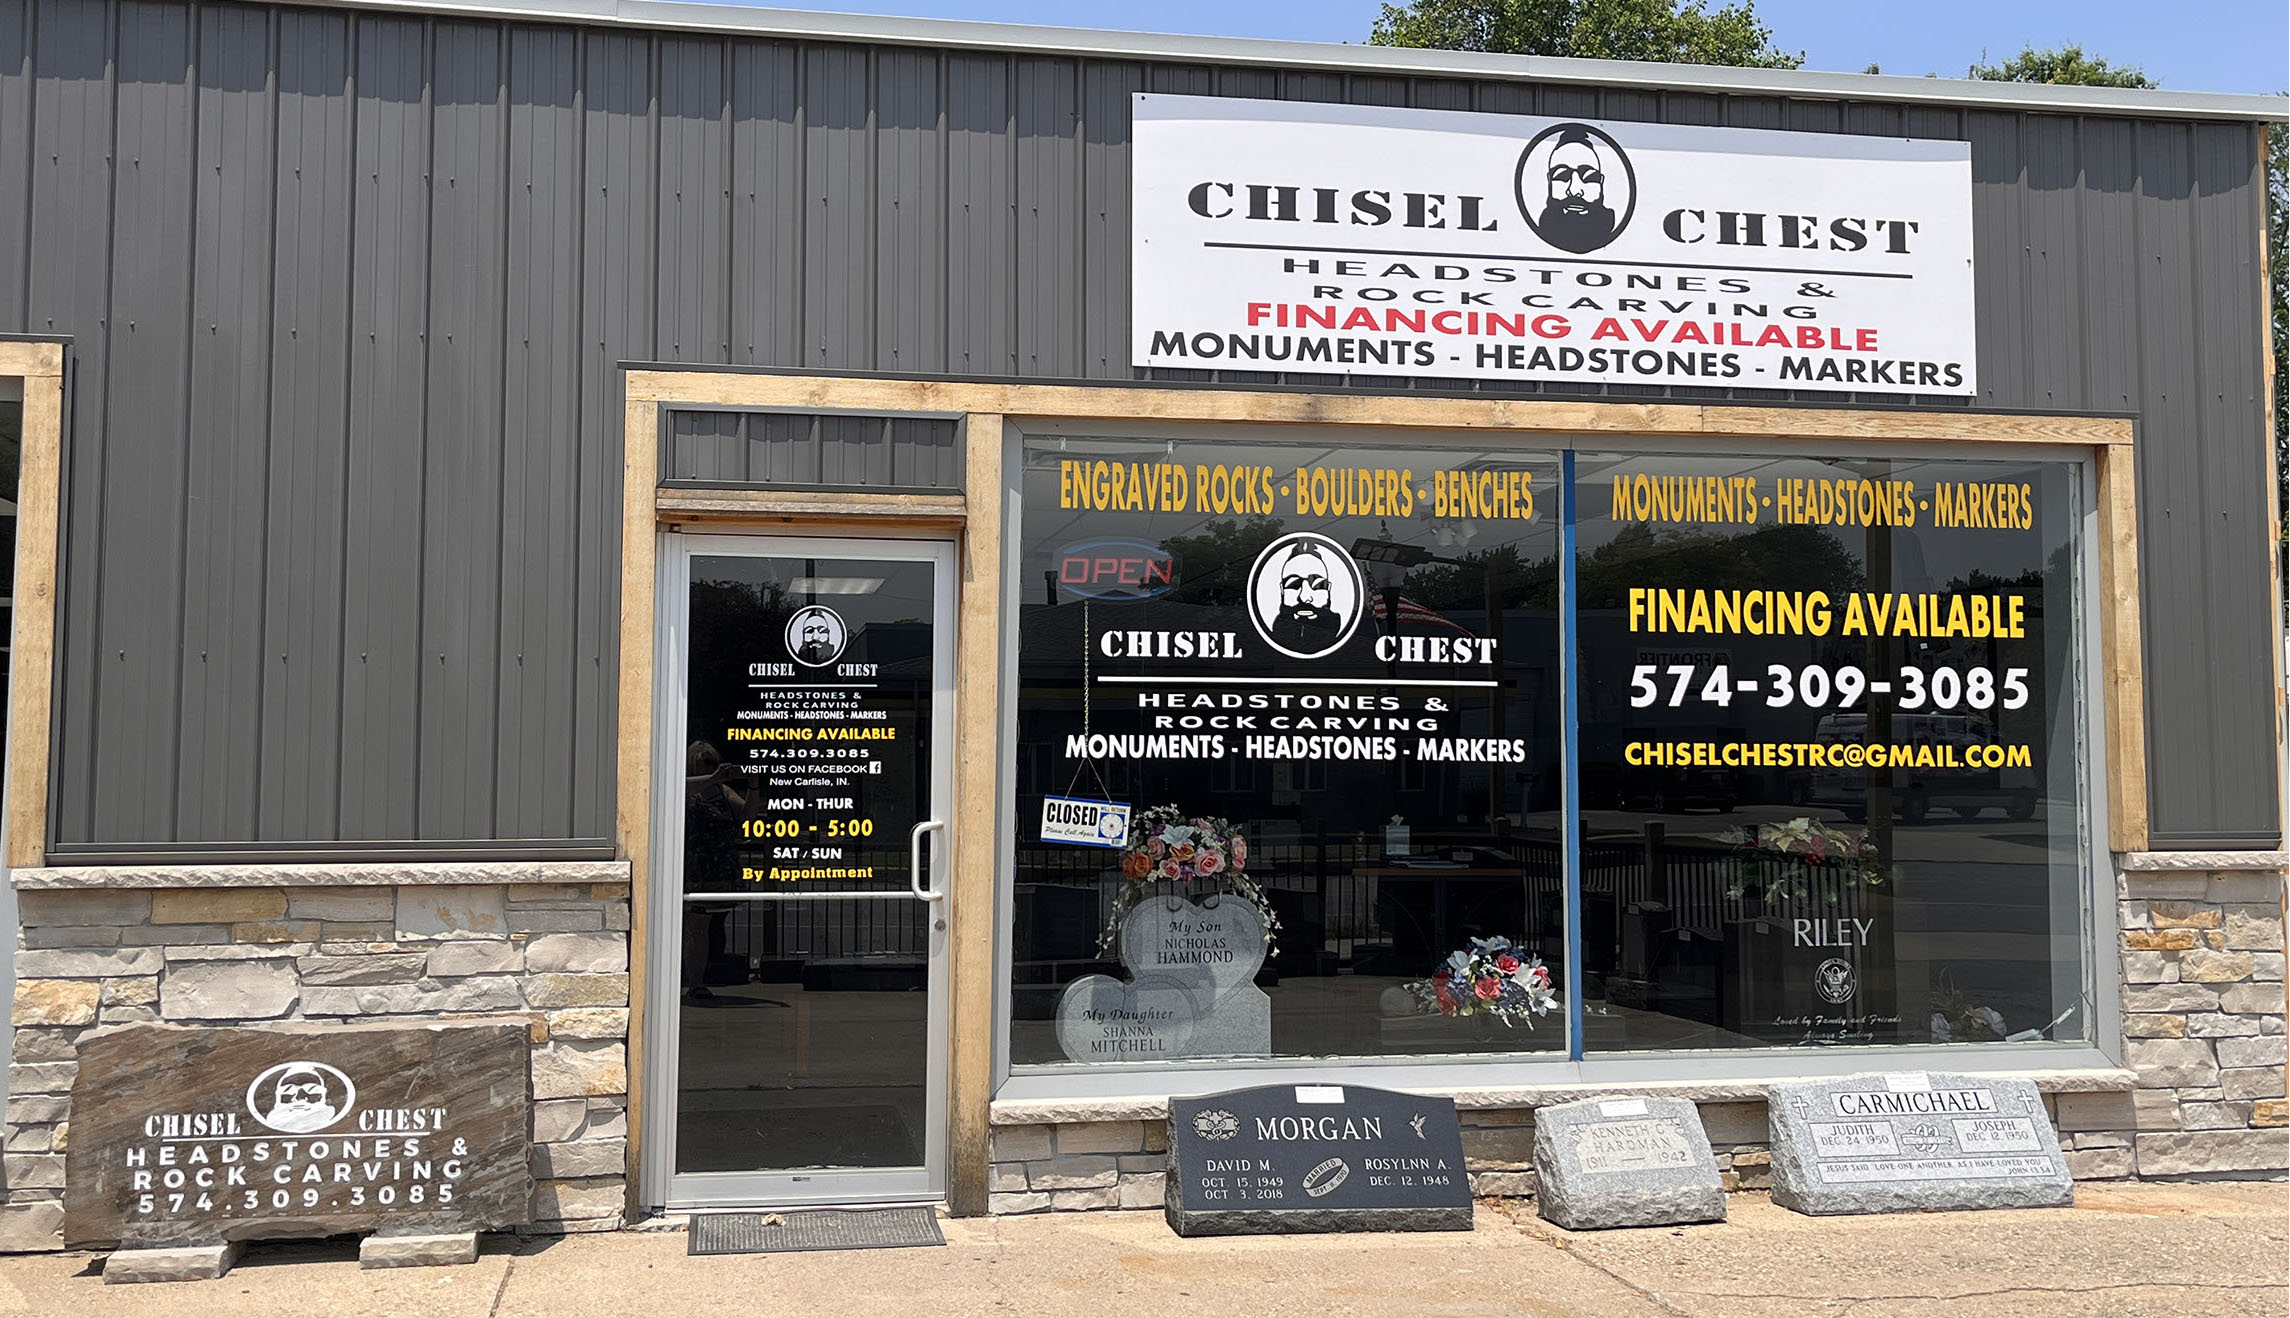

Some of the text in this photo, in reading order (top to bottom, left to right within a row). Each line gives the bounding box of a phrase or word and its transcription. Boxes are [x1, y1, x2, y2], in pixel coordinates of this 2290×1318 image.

[1188, 183, 1918, 253] CHISEL CHEST
[1284, 258, 1835, 297] HEADSTONES &
[1314, 286, 1817, 319] ROCK CARVING
[1248, 303, 1877, 351] FINANCING AVAILABLE
[1151, 331, 1434, 366] MONUMENTS
[1476, 344, 1742, 379] HEADSTONES
[1780, 356, 1962, 387] MARKERS
[1060, 460, 1533, 519] ENGRAVED ROCKS BOULDERS BENCHES
[1612, 474, 2032, 530] MONUMENTS HEADSTONES MARKERS
[1060, 557, 1173, 584] OPEN
[1630, 588, 2024, 638] FINANCING AVAILABLE
[1101, 631, 1496, 663] CHISEL CHEST
[749, 664, 877, 676] CHISEL CHEST
[1631, 665, 2028, 709] 574-309-3085
[1140, 694, 1448, 711] HEADSTONES &
[737, 711, 788, 719] MONUMENTS
[795, 711, 844, 719] HEADSTONES
[851, 711, 886, 719] MARKERS
[1156, 716, 1437, 730] ROCK CARVING
[728, 728, 895, 740] FINANCING AVAILABLE
[750, 749, 868, 758] 574.309.3085
[1066, 735, 1224, 758] MONUMENTS
[1247, 736, 1396, 760] HEADSTONES
[1418, 738, 1524, 762] MARKERS
[1625, 742, 2031, 767] CHISELCHESTRC@GMAIL.COM
[771, 765, 786, 773] US
[789, 765, 805, 773] ON
[808, 765, 867, 773] FACEBOOK
[795, 778, 833, 786] Carlisle,
[768, 799, 804, 810] MON
[816, 798, 853, 809] THUR
[1047, 802, 1098, 826] CLOSED
[743, 820, 799, 837] 10:00
[828, 819, 872, 836] 5:00
[773, 847, 799, 858] SAT
[812, 848, 841, 859] SUN
[743, 867, 872, 881] By Appointment
[1169, 920, 1221, 936] My Son
[1793, 918, 1873, 947] RILEY
[1165, 938, 1226, 950] NICHOLAS
[1157, 950, 1233, 964] HAMMOND
[1083, 1007, 1174, 1024] My Daughter
[1801, 1016, 1812, 1027] by
[1815, 1015, 1847, 1026] Family
[1848, 1016, 1866, 1024] and
[1103, 1027, 1153, 1038] SHANNA
[1091, 1039, 1166, 1053] MITCHELL
[1840, 1092, 1989, 1115] CARMICHAEL
[145, 1107, 448, 1138] CHISEL CHEST
[1255, 1117, 1381, 1140] MORGAN
[1830, 1124, 1875, 1136] JUDITH
[1972, 1121, 2017, 1132] JOSEPH
[1590, 1125, 1650, 1139] KENNETH
[2005, 1131, 2029, 1140] 1950
[1594, 1137, 1671, 1152] HARDMAN
[1845, 1136, 1860, 1145] 24
[1866, 1135, 1889, 1145] 1950
[127, 1138, 468, 1167] HEADSTONES &
[1658, 1151, 1687, 1162] 1942
[1206, 1159, 1275, 1172] DAVID M.
[1306, 1160, 1336, 1184] MARRIED
[1365, 1159, 1451, 1170] ROSYLNN A.
[134, 1161, 462, 1190] ROCK CARVING
[1257, 1177, 1283, 1187] 1949
[1370, 1176, 1395, 1186] DEC.
[1423, 1175, 1450, 1186] 1948
[139, 1183, 453, 1213] 574.309.3085
[1257, 1188, 1283, 1199] 2018
